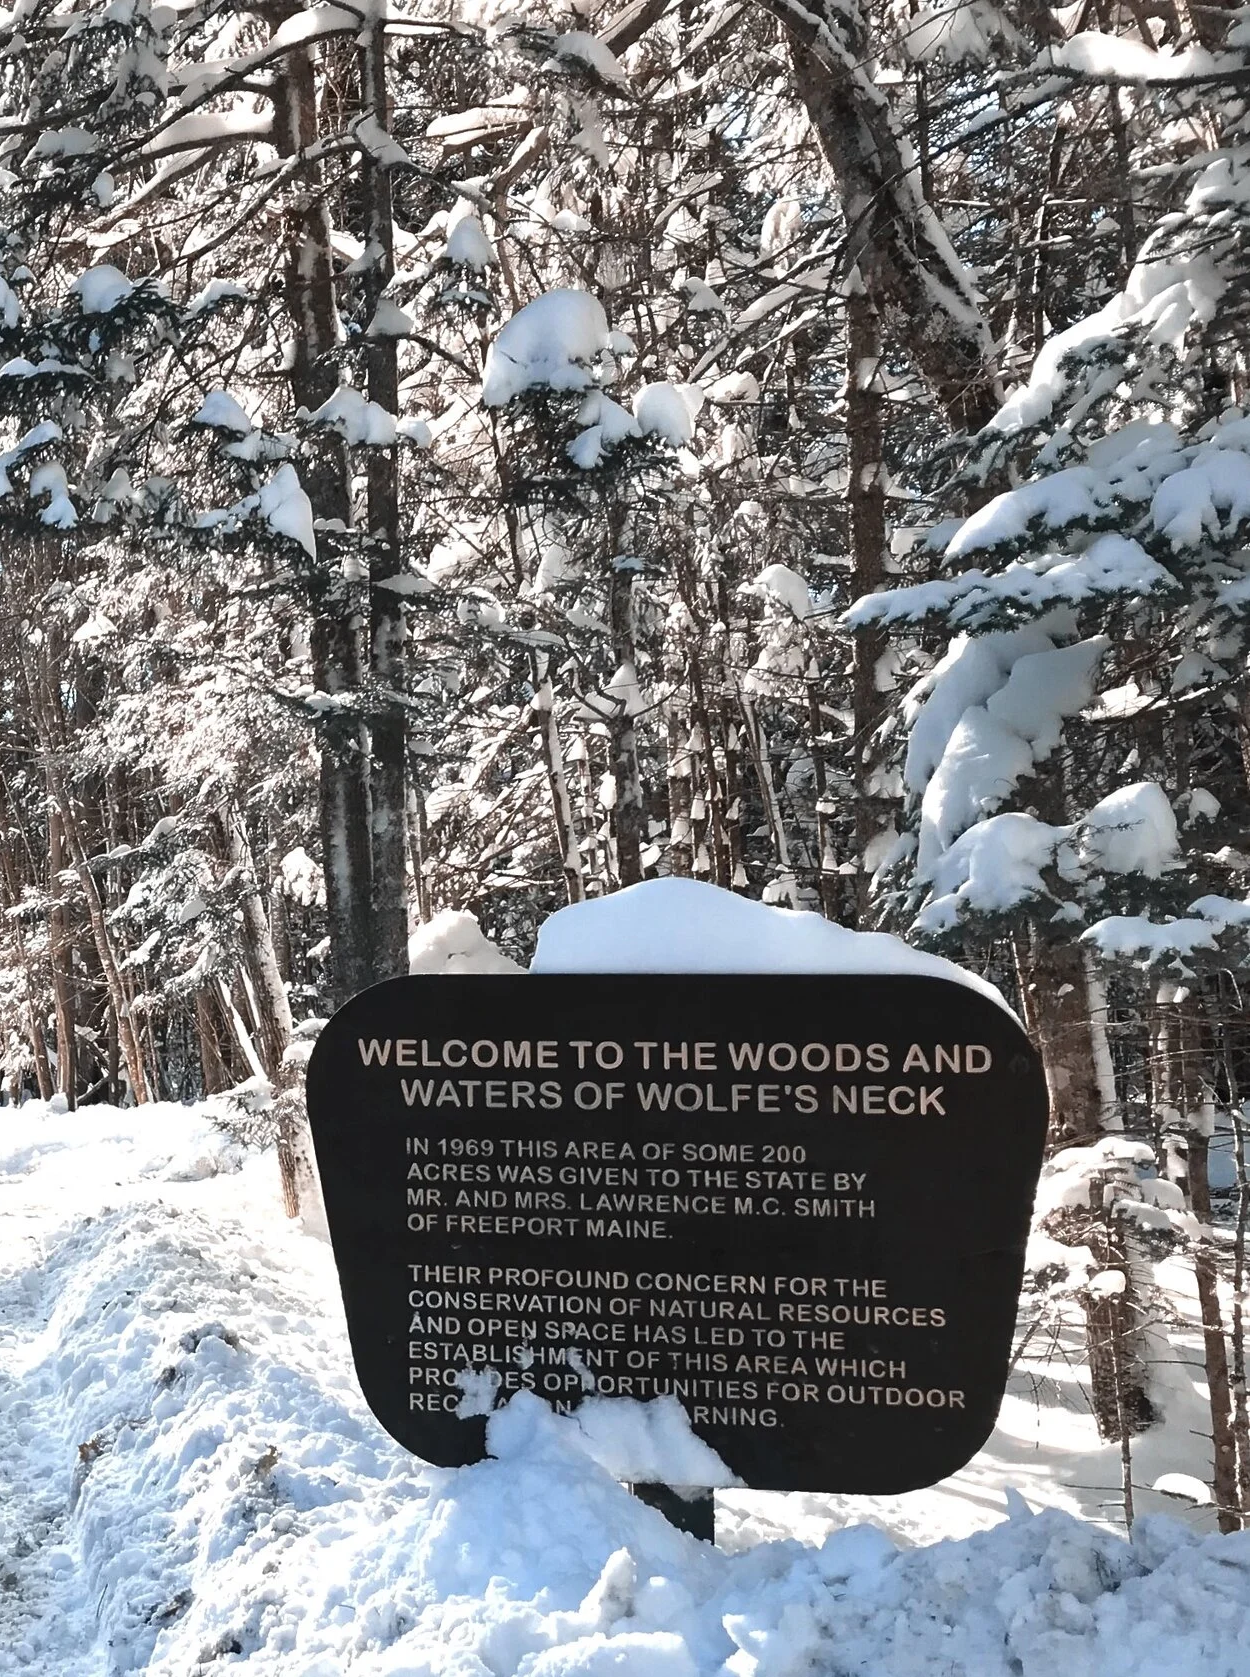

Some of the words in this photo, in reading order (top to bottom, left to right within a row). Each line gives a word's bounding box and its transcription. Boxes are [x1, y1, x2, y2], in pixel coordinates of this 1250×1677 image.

[358, 1039, 558, 1068] WELCOME
[569, 1041, 623, 1069] TO
[634, 1042, 717, 1070] THE
[729, 1043, 889, 1072] WOODS
[903, 1044, 992, 1073] AND
[401, 1079, 562, 1108] WATERS
[575, 1082, 625, 1109] OF
[637, 1083, 818, 1113] WOLFE'S
[833, 1085, 945, 1115] NECK
[407, 1138, 428, 1155] IN
[438, 1139, 493, 1156] 1969
[501, 1140, 557, 1158] THIS
[565, 1142, 635, 1159] AREA
[643, 1143, 674, 1160] OF
[683, 1144, 754, 1162] SOME
[762, 1146, 805, 1163] 200
[407, 1163, 490, 1182] ACRES
[497, 1165, 552, 1183] WAS
[560, 1167, 637, 1185] GIVEN
[646, 1169, 679, 1186] TO
[687, 1170, 738, 1188] THE
[746, 1171, 825, 1190] STATE
[834, 1173, 866, 1190] BY
[407, 1189, 448, 1208] MR.
[456, 1190, 507, 1207] AND
[515, 1192, 572, 1211] MRS.
[581, 1193, 725, 1213] LAWRENCE
[735, 1197, 785, 1215] M.C.
[795, 1199, 874, 1217] SMITH
[408, 1214, 437, 1231] OF
[447, 1215, 578, 1235] FREEPORT
[587, 1220, 672, 1238] MAINE.
[408, 1265, 480, 1284] THEIR
[489, 1268, 628, 1289] PROFOUND
[636, 1272, 765, 1295] CONCERN
[775, 1277, 826, 1296] FOR
[834, 1279, 886, 1297] THE
[409, 1290, 601, 1314] CONSERVATION
[610, 1298, 641, 1315] OF
[651, 1299, 770, 1320] NATURAL
[779, 1304, 945, 1326] RESOURCES
[409, 1317, 460, 1334] AND
[468, 1317, 536, 1339] OPEN
[545, 1321, 625, 1341] SPACE
[634, 1325, 686, 1344] HAS
[695, 1327, 744, 1345] LED
[752, 1329, 785, 1347] TO
[793, 1331, 844, 1349] THE
[627, 1351, 659, 1368] OF
[668, 1353, 727, 1371] THIS
[736, 1355, 807, 1375] AREA
[815, 1358, 905, 1378] WHICH
[409, 1367, 536, 1389] PRODES
[767, 1383, 819, 1402] FOR
[827, 1385, 965, 1408] OUTDOOR
[693, 1406, 785, 1427] RNING.
